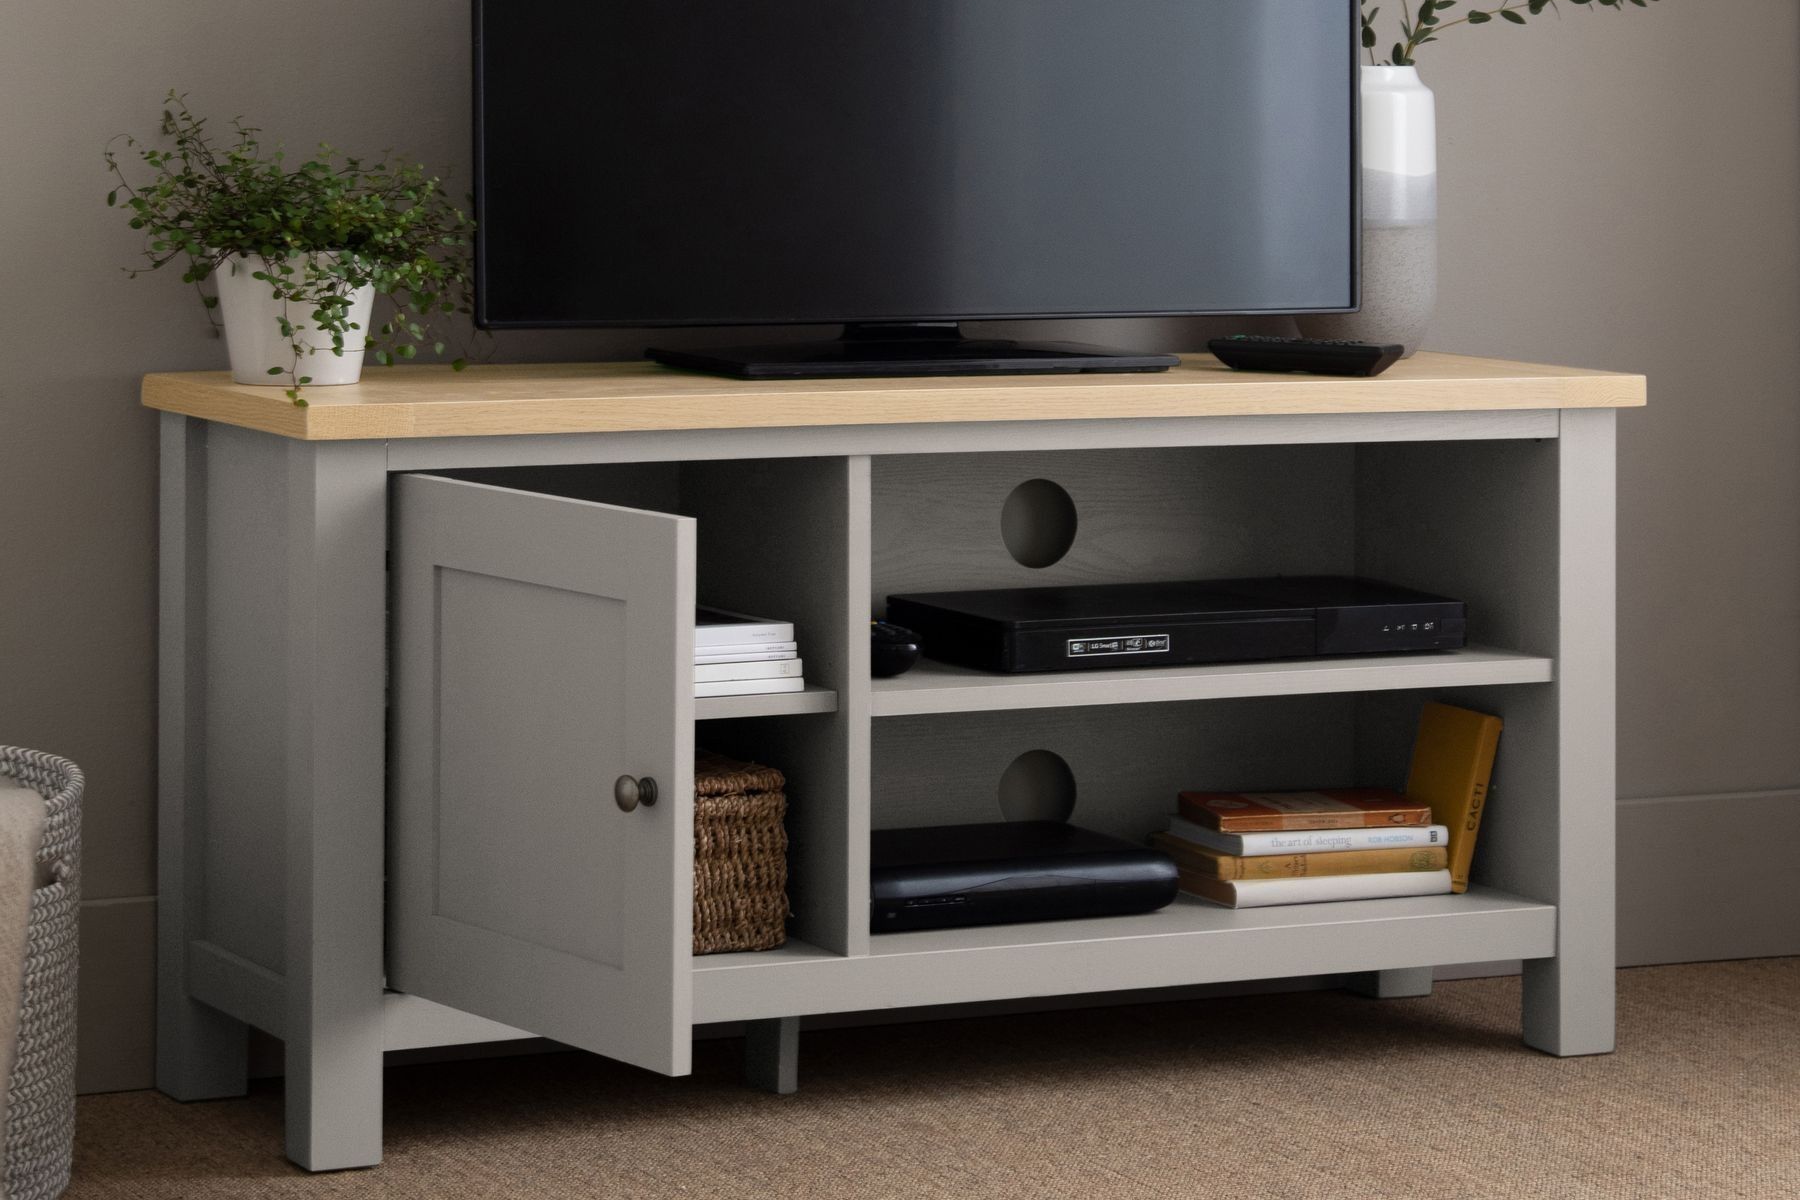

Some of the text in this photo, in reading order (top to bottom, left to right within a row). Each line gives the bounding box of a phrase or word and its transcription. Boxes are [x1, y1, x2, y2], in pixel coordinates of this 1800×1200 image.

[1466, 783, 1484, 831] CACTI
[1271, 834, 1352, 849] the art of sleeping
